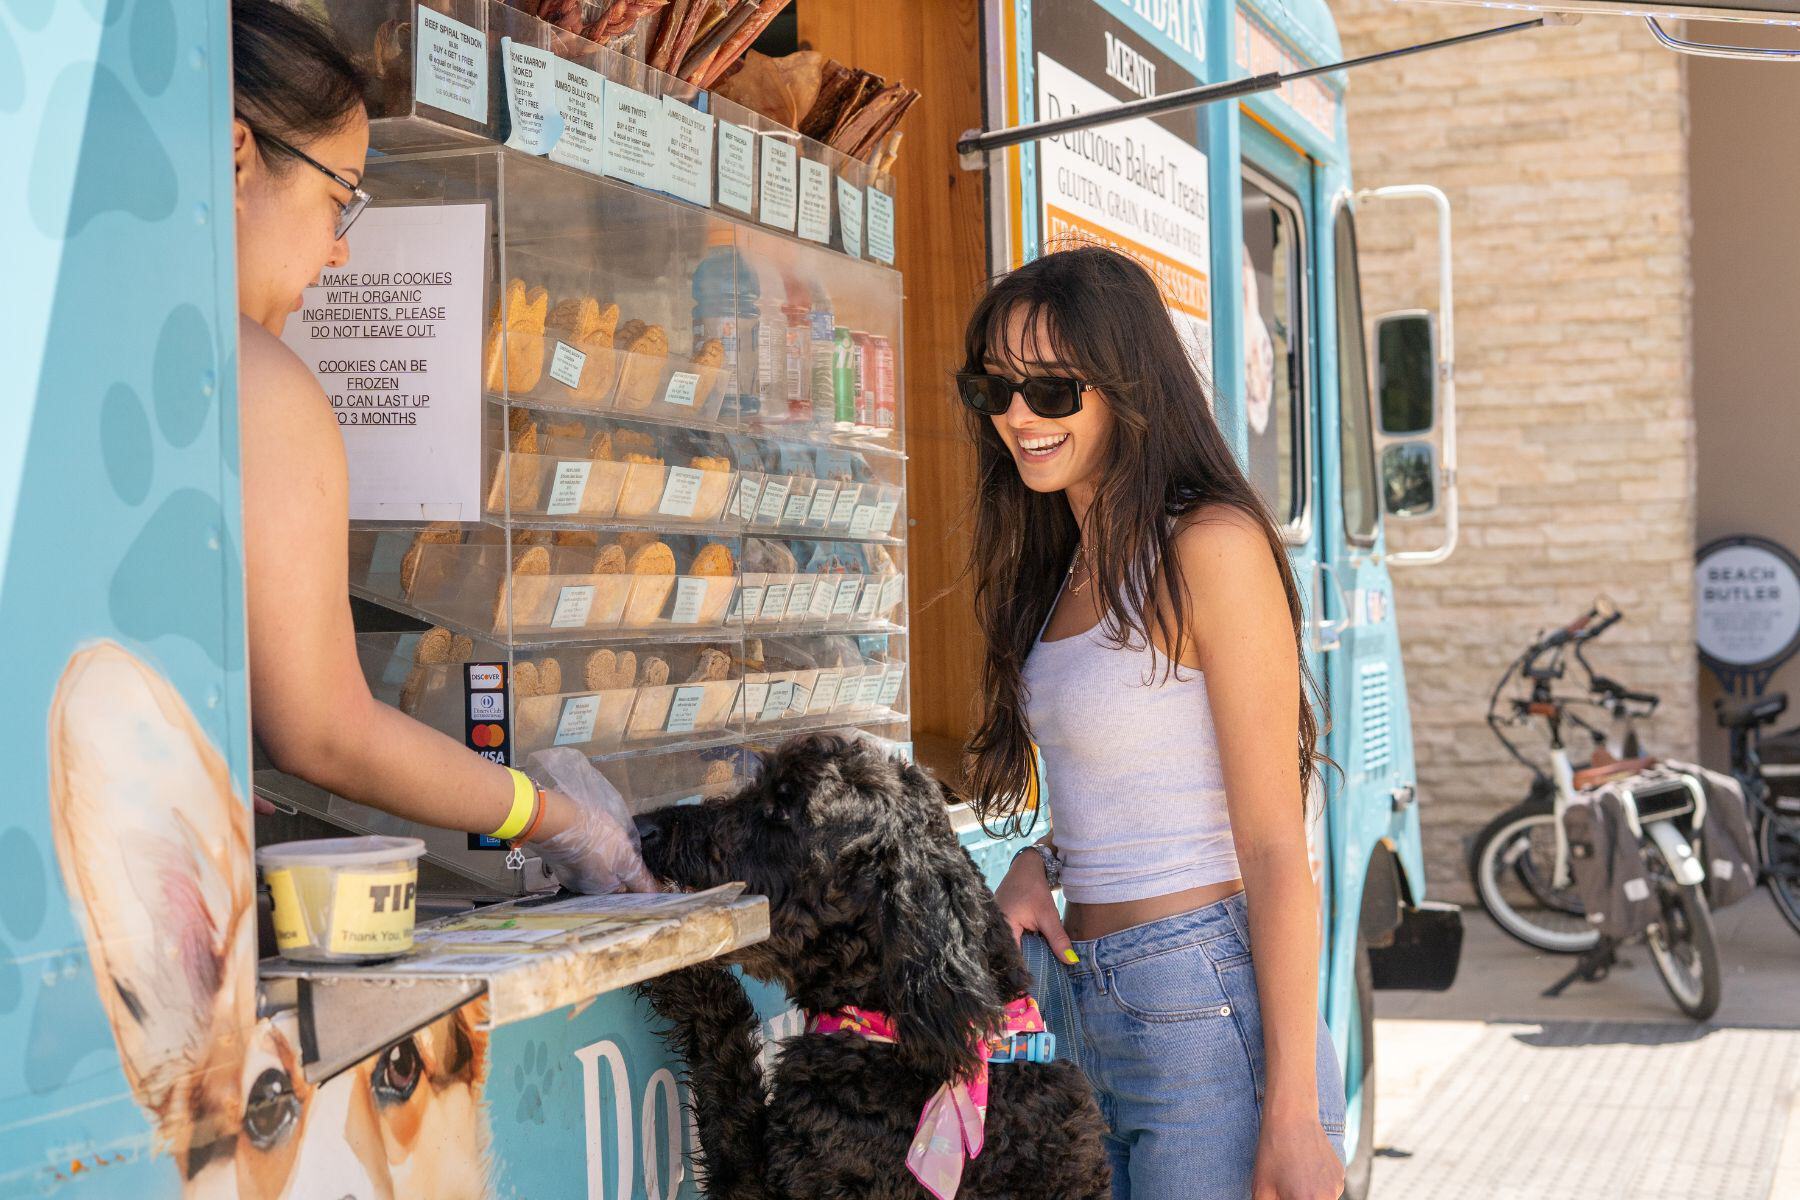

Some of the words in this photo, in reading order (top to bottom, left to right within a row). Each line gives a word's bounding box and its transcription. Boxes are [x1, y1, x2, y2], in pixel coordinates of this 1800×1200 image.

[424, 17, 439, 31] BEEF
[439, 24, 460, 40] SPIRAL
[460, 32, 483, 49] TENDON
[433, 44, 443, 54] BUY
[448, 50, 457, 60] GET
[462, 55, 474, 67] FREE
[524, 55, 547, 69] MARROW
[512, 65, 533, 78] MOKED
[1105, 31, 1156, 99] MENU
[567, 72, 588, 88] BRAIDED
[571, 86, 587, 98] BULLY
[587, 92, 600, 104] STICK
[528, 101, 539, 110] FREE
[619, 102, 631, 115] LAMB
[572, 115, 580, 124] GET
[583, 119, 594, 130] FREE
[1126, 136, 1165, 200] Baked
[1168, 161, 1205, 221] Treats
[1152, 212, 1181, 250] SUGAR
[1182, 226, 1202, 259] FREE
[323, 274, 358, 286] MAKE
[361, 273, 390, 286] OUR
[393, 272, 452, 285] COOKIES
[326, 290, 359, 303] WITH
[361, 289, 422, 303] ORGANIC
[302, 307, 392, 321] INGREDIENTS,
[396, 306, 446, 320] PLEASE
[311, 325, 330, 338] DO
[333, 325, 360, 338] NOT
[363, 325, 403, 337] LEAVE
[406, 324, 436, 337] OUT.
[318, 360, 376, 372] COOKIES
[380, 360, 407, 372] CAN
[411, 360, 427, 372] BE
[347, 377, 399, 389] FROZEN
[327, 395, 343, 406] ND
[346, 395, 373, 407] CAN
[377, 395, 409, 407] LAST
[412, 395, 430, 406] UP
[350, 412, 360, 424] 3
[362, 412, 417, 424] MONTHS
[1708, 566, 1776, 581] BEACH
[1704, 585, 1781, 602] BUTLER
[471, 673, 500, 682] DISCOVER
[473, 706, 488, 714] Diners
[489, 706, 502, 714] Club
[342, 930, 377, 943] Thank
